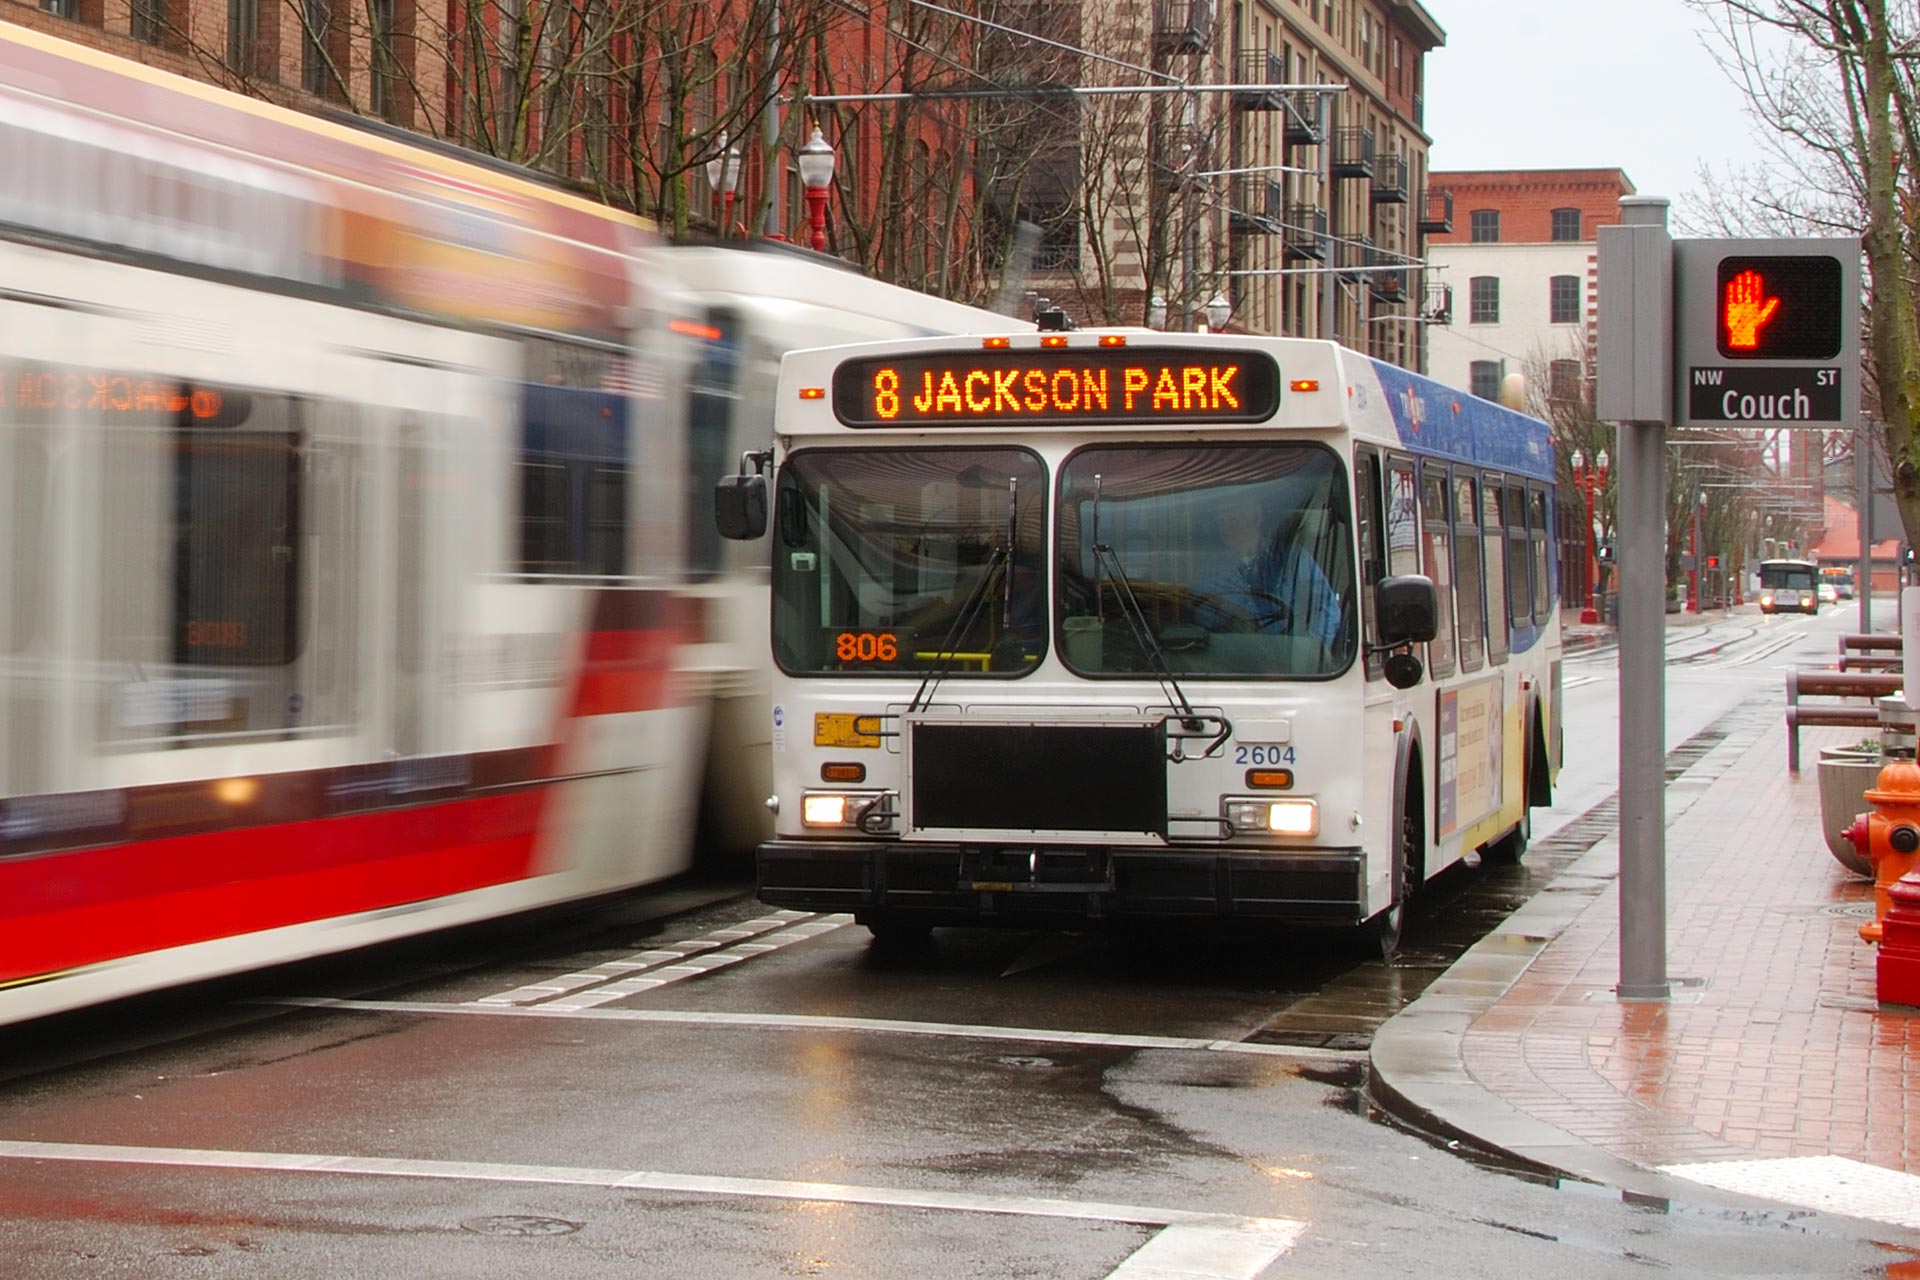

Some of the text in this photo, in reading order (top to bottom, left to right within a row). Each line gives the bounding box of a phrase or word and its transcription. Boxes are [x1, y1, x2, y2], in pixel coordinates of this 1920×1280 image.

[1694, 370, 1837, 386] NW ST
[874, 367, 1238, 418] 8 JACKSON PARK
[1722, 388, 1809, 419] Couch
[837, 633, 897, 661] 806
[1235, 746, 1296, 765] 2604
